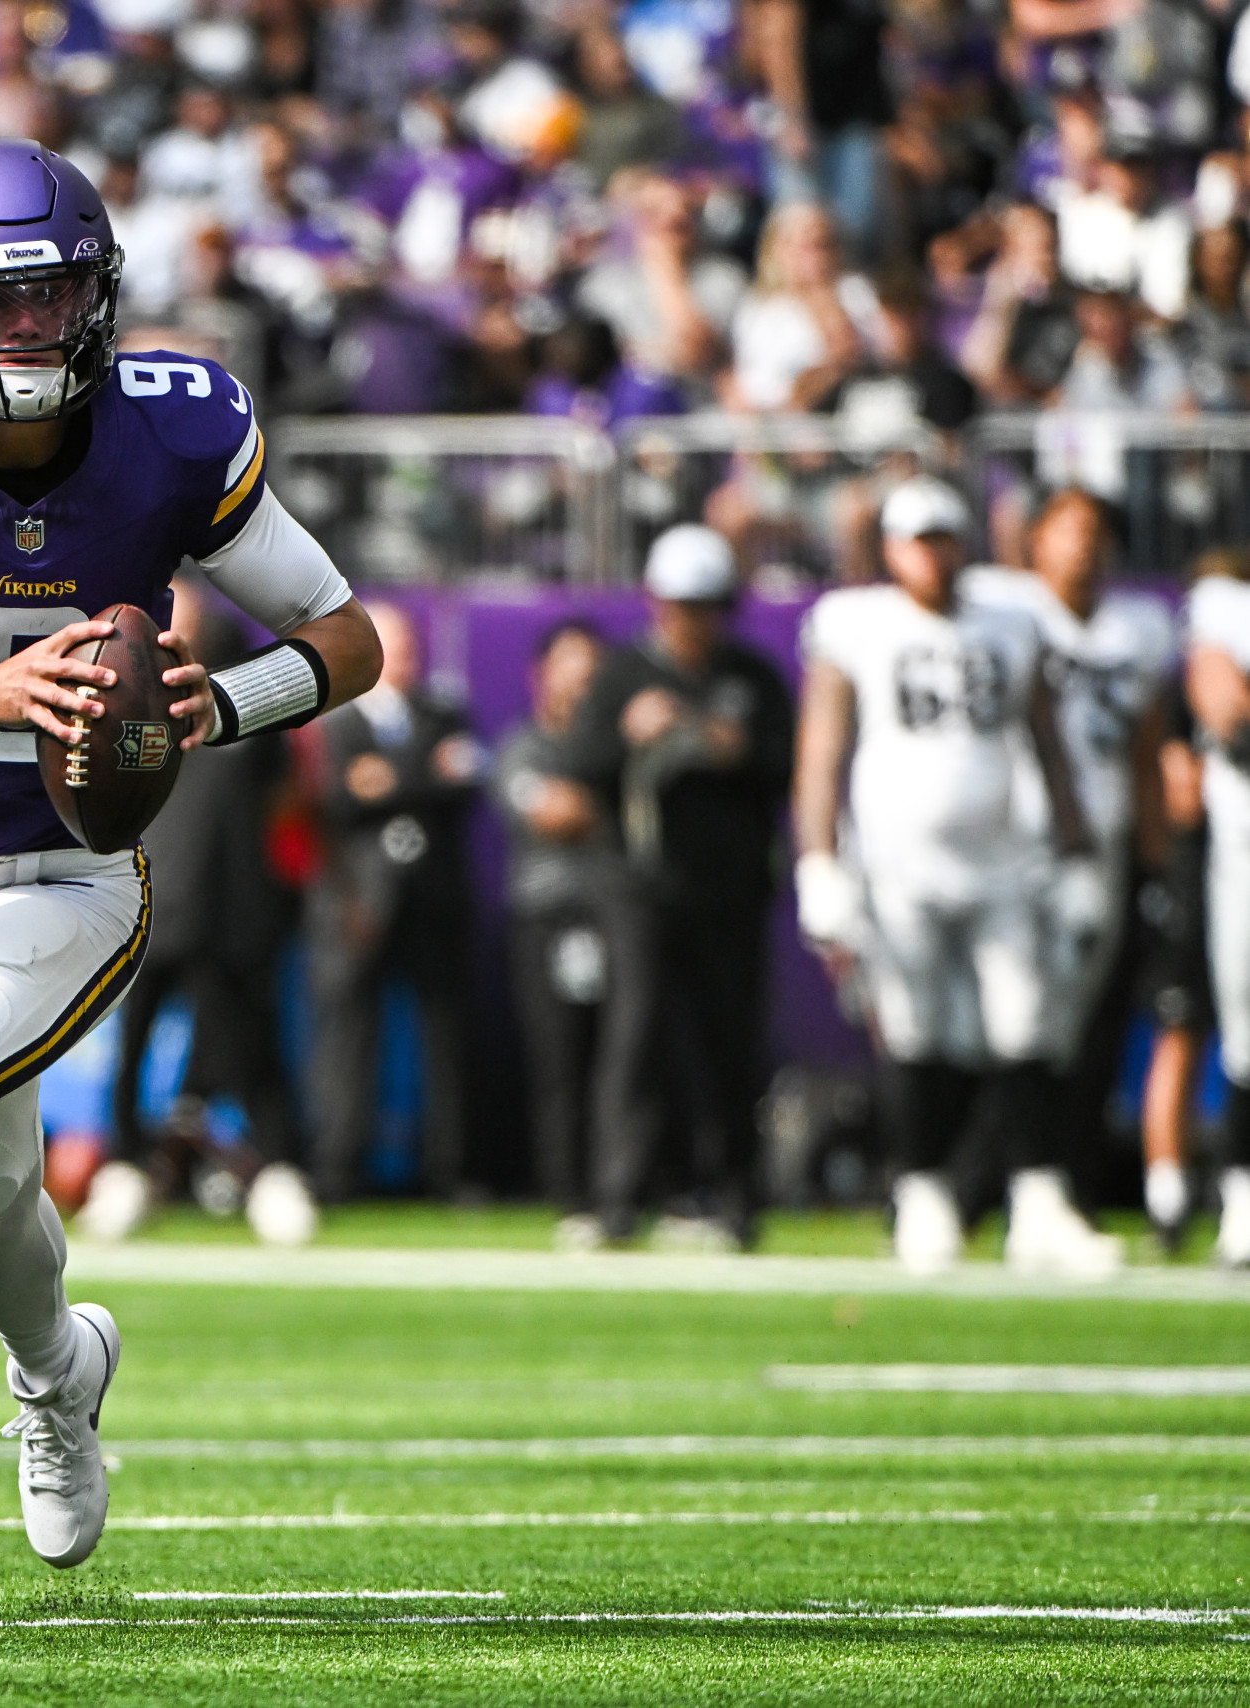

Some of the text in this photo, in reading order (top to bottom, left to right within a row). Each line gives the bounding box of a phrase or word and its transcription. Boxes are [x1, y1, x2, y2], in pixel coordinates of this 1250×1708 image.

[118, 360, 212, 398] 9
[20, 533, 40, 547] NFL
[141, 727, 168, 765] NFL
